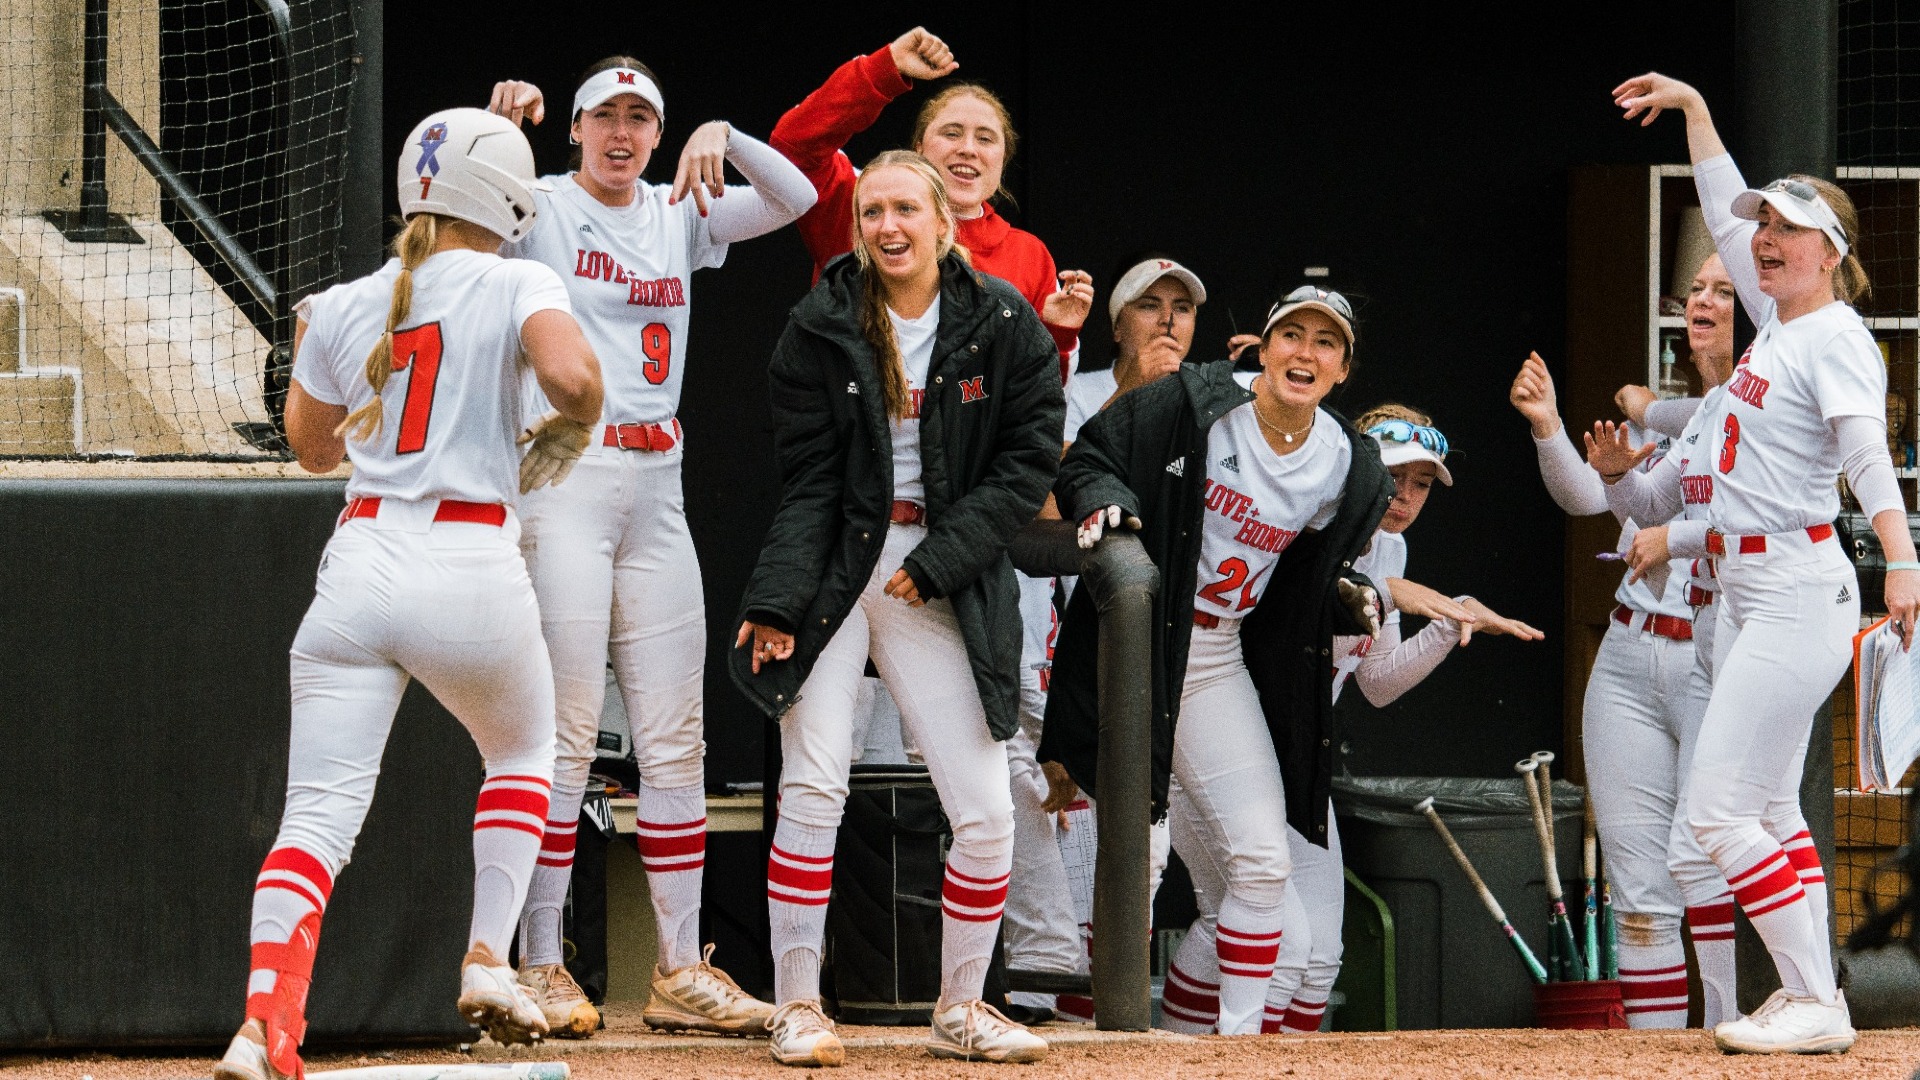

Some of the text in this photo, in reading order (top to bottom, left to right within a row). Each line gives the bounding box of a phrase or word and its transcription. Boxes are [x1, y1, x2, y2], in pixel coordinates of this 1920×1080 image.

[616, 71, 636, 86] M
[424, 128, 446, 141] M
[420, 176, 432, 200] 7
[575, 249, 629, 285] LOVE
[627, 276, 686, 308] HONOR
[641, 322, 672, 386] 9
[391, 321, 443, 455] 7
[958, 375, 989, 404] M
[1719, 412, 1740, 476] 3
